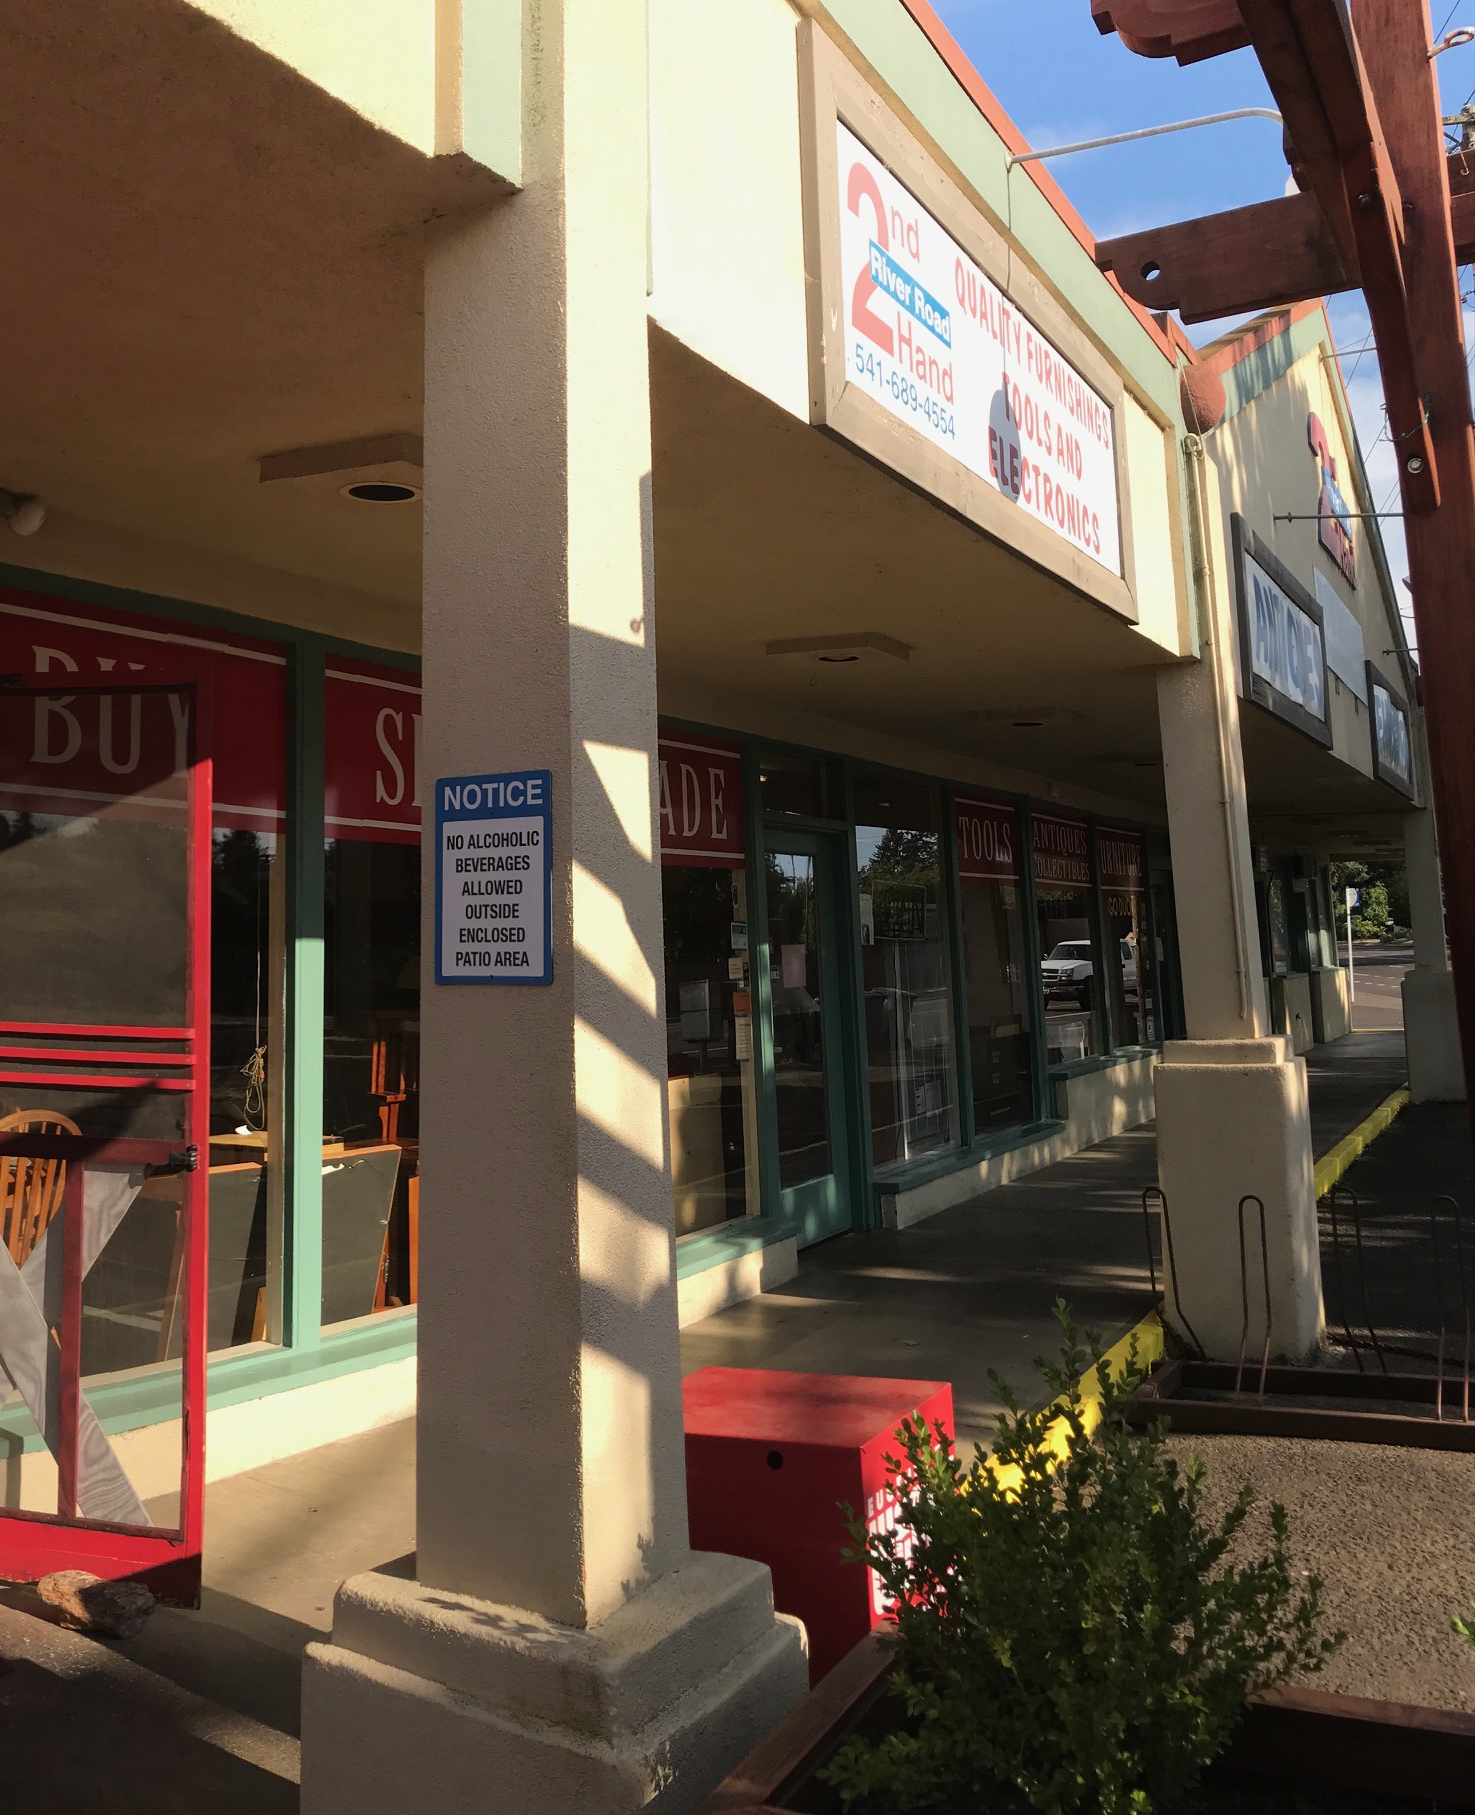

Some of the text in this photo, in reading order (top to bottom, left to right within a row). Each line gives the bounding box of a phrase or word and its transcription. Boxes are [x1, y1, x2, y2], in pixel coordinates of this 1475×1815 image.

[870, 252, 951, 341] River Road
[897, 310, 954, 405] Hand
[955, 256, 1109, 450] QUALITY FURNISHINGS
[855, 343, 955, 440] 541-689-4554
[1001, 371, 1083, 482] TOOLS AND
[988, 425, 1100, 556] ELECTRONICS
[444, 779, 543, 811] NOTICE
[446, 830, 540, 850] NO ALCOHOLIC
[958, 816, 1013, 864] TOOLS
[1033, 821, 1087, 856] ANTIQUES
[455, 855, 530, 873] BEVERAGES
[1098, 839, 1142, 877] URNITURE
[461, 879, 523, 896] ALLOWED
[465, 903, 520, 920] OUTSIDE
[459, 927, 526, 943] ENCLOSED
[455, 951, 530, 967] PATIO AREA
